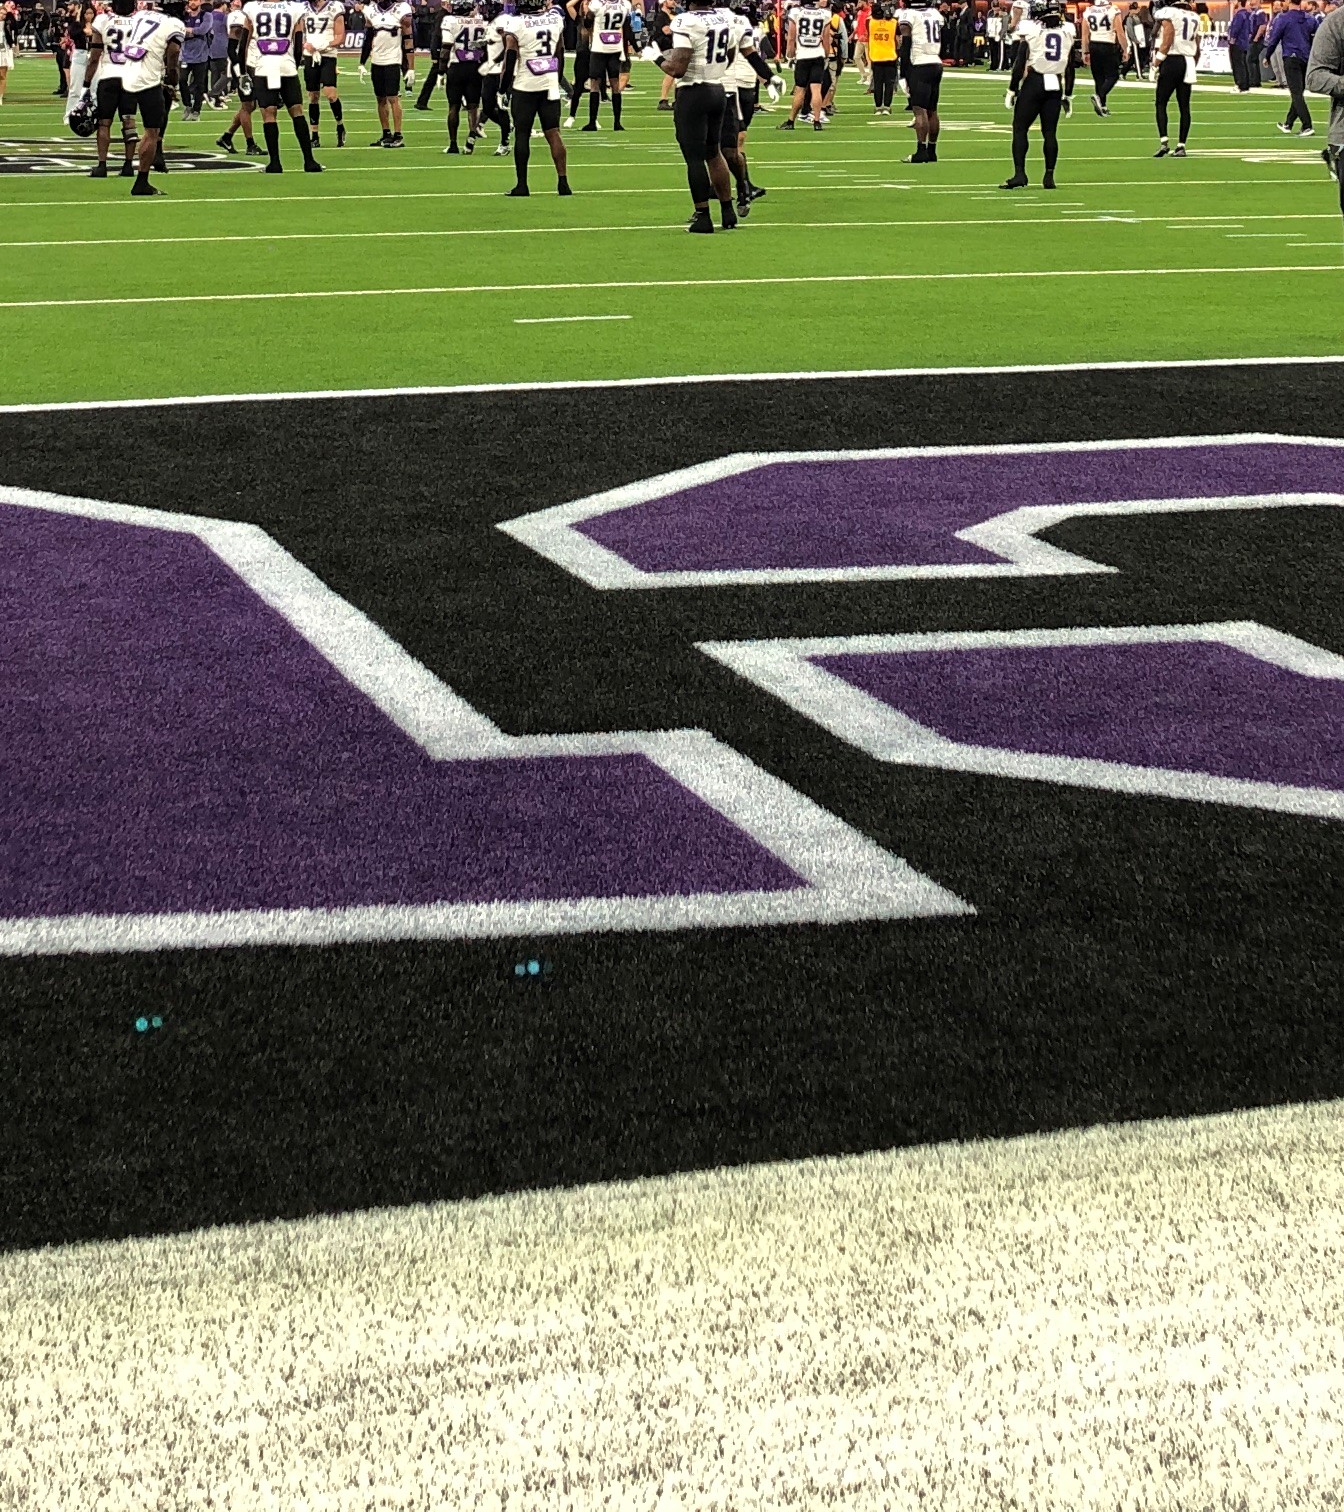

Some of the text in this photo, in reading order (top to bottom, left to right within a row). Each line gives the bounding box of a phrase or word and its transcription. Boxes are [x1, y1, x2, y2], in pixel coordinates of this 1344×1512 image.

[131, 16, 160, 45] 17
[256, 13, 293, 38] 80
[306, 16, 329, 34] 87
[602, 12, 623, 31] 12
[798, 17, 824, 37] 89
[925, 18, 941, 45] 10
[1087, 13, 1112, 31] 84
[535, 30, 553, 57] 3
[706, 27, 731, 65] 19
[1044, 33, 1062, 62] 9
